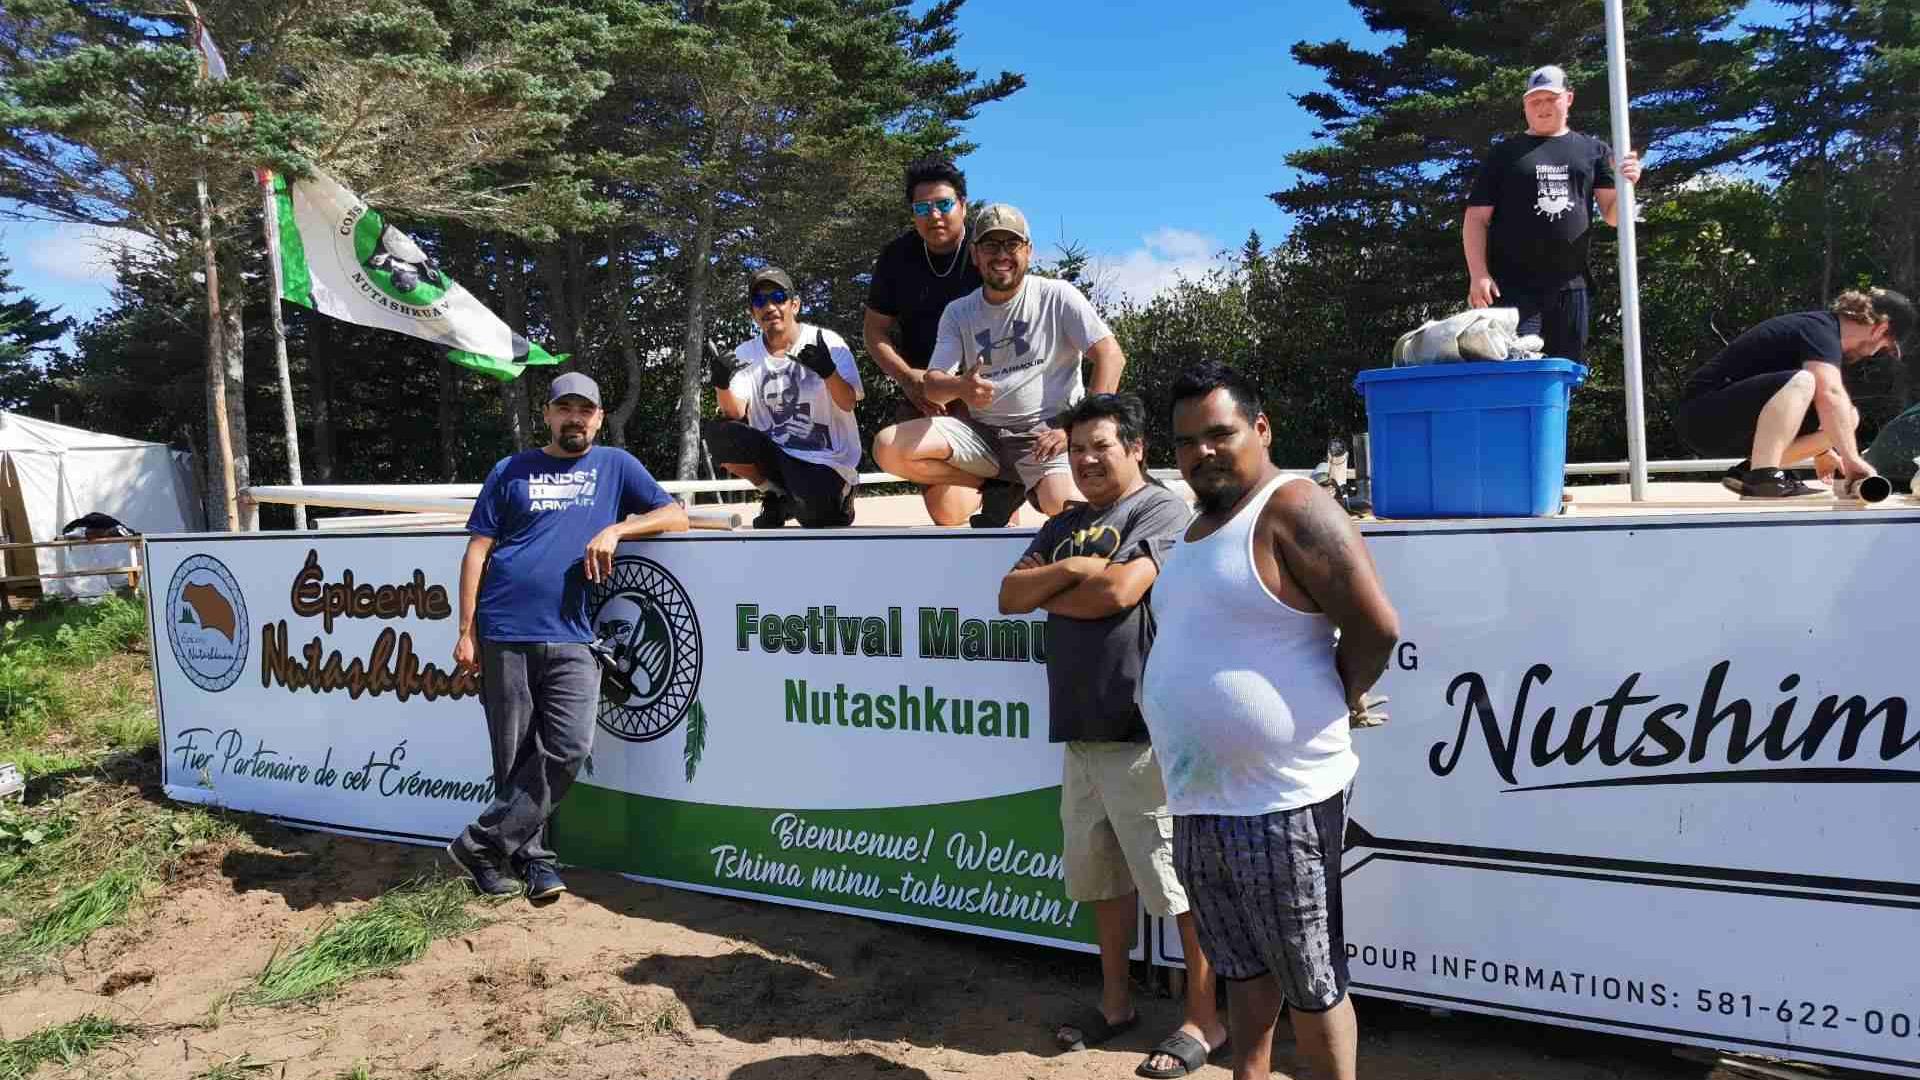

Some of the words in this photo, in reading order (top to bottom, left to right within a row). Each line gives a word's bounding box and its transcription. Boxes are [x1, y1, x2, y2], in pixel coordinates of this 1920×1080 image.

[530, 498, 594, 511] ARMUR
[291, 549, 451, 634] Épicerie
[736, 603, 903, 658] Festival
[784, 678, 1030, 740] Nutashkuan
[216, 728, 311, 784] Partenaire
[313, 747, 337, 789] de
[342, 751, 393, 793] cet
[710, 843, 806, 889] Tshima
[770, 811, 936, 864] Bienvenue!
[1344, 942, 1417, 972] POUR
[1431, 953, 1679, 1009] INFORMATIONS:
[1696, 989, 1920, 1038] 581-622-00
